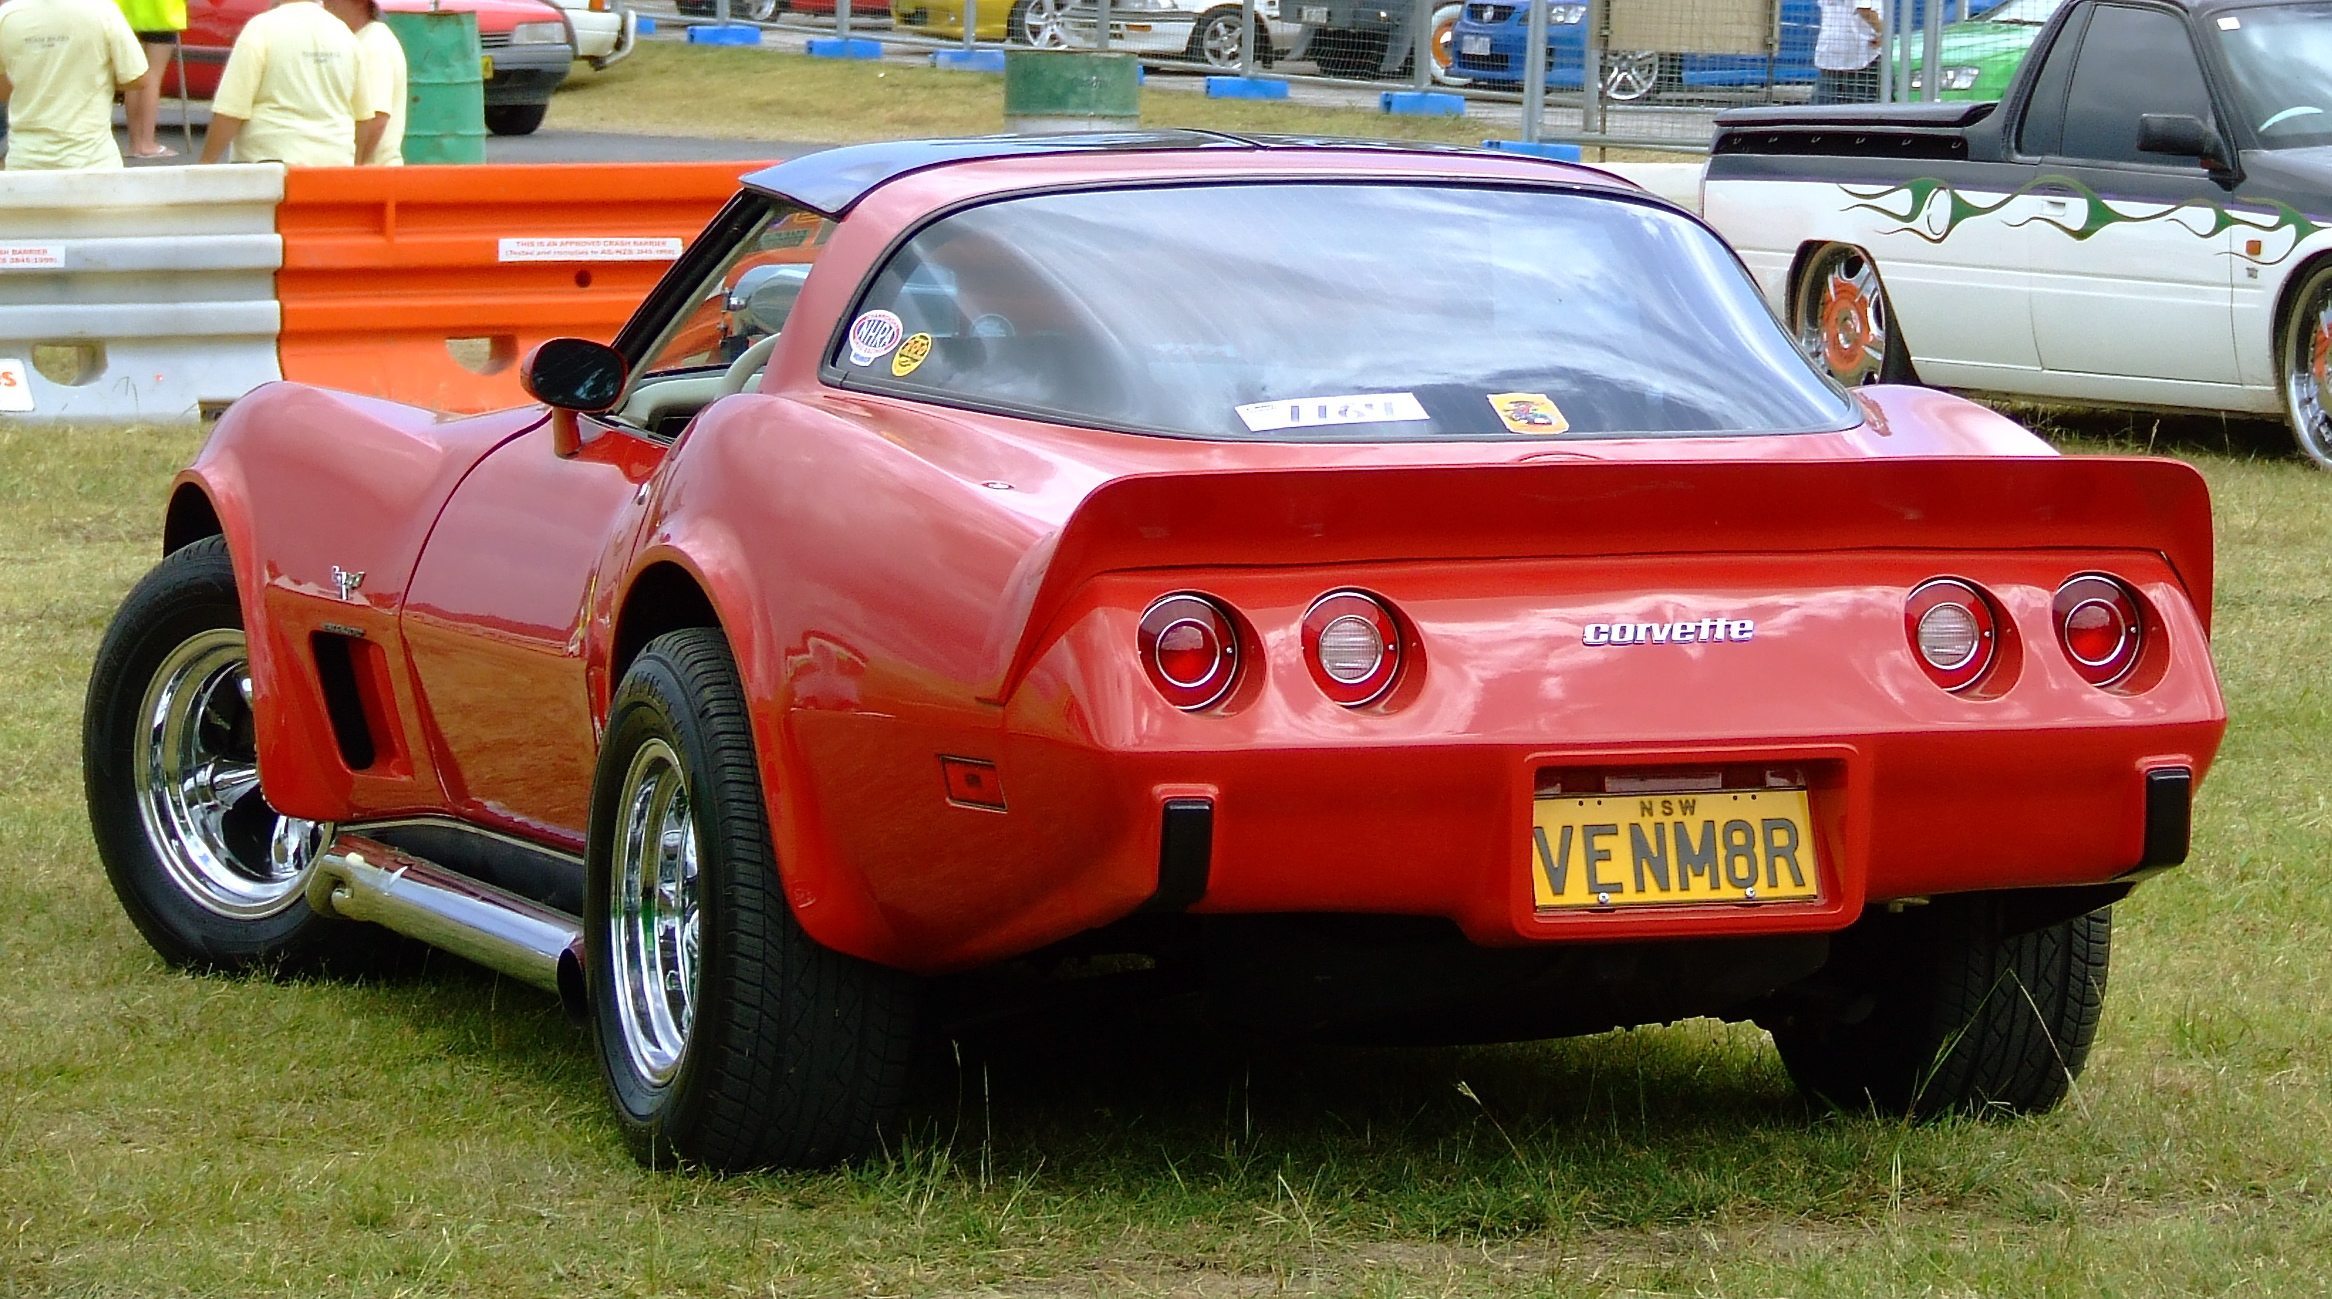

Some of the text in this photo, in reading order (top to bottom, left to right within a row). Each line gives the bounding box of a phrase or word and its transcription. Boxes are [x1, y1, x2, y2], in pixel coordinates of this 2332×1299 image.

[858, 319, 895, 348] NHRA
[1582, 617, 1755, 646] corvette
[1639, 798, 1697, 818] NSW
[1534, 818, 1806, 896] VENM8R
